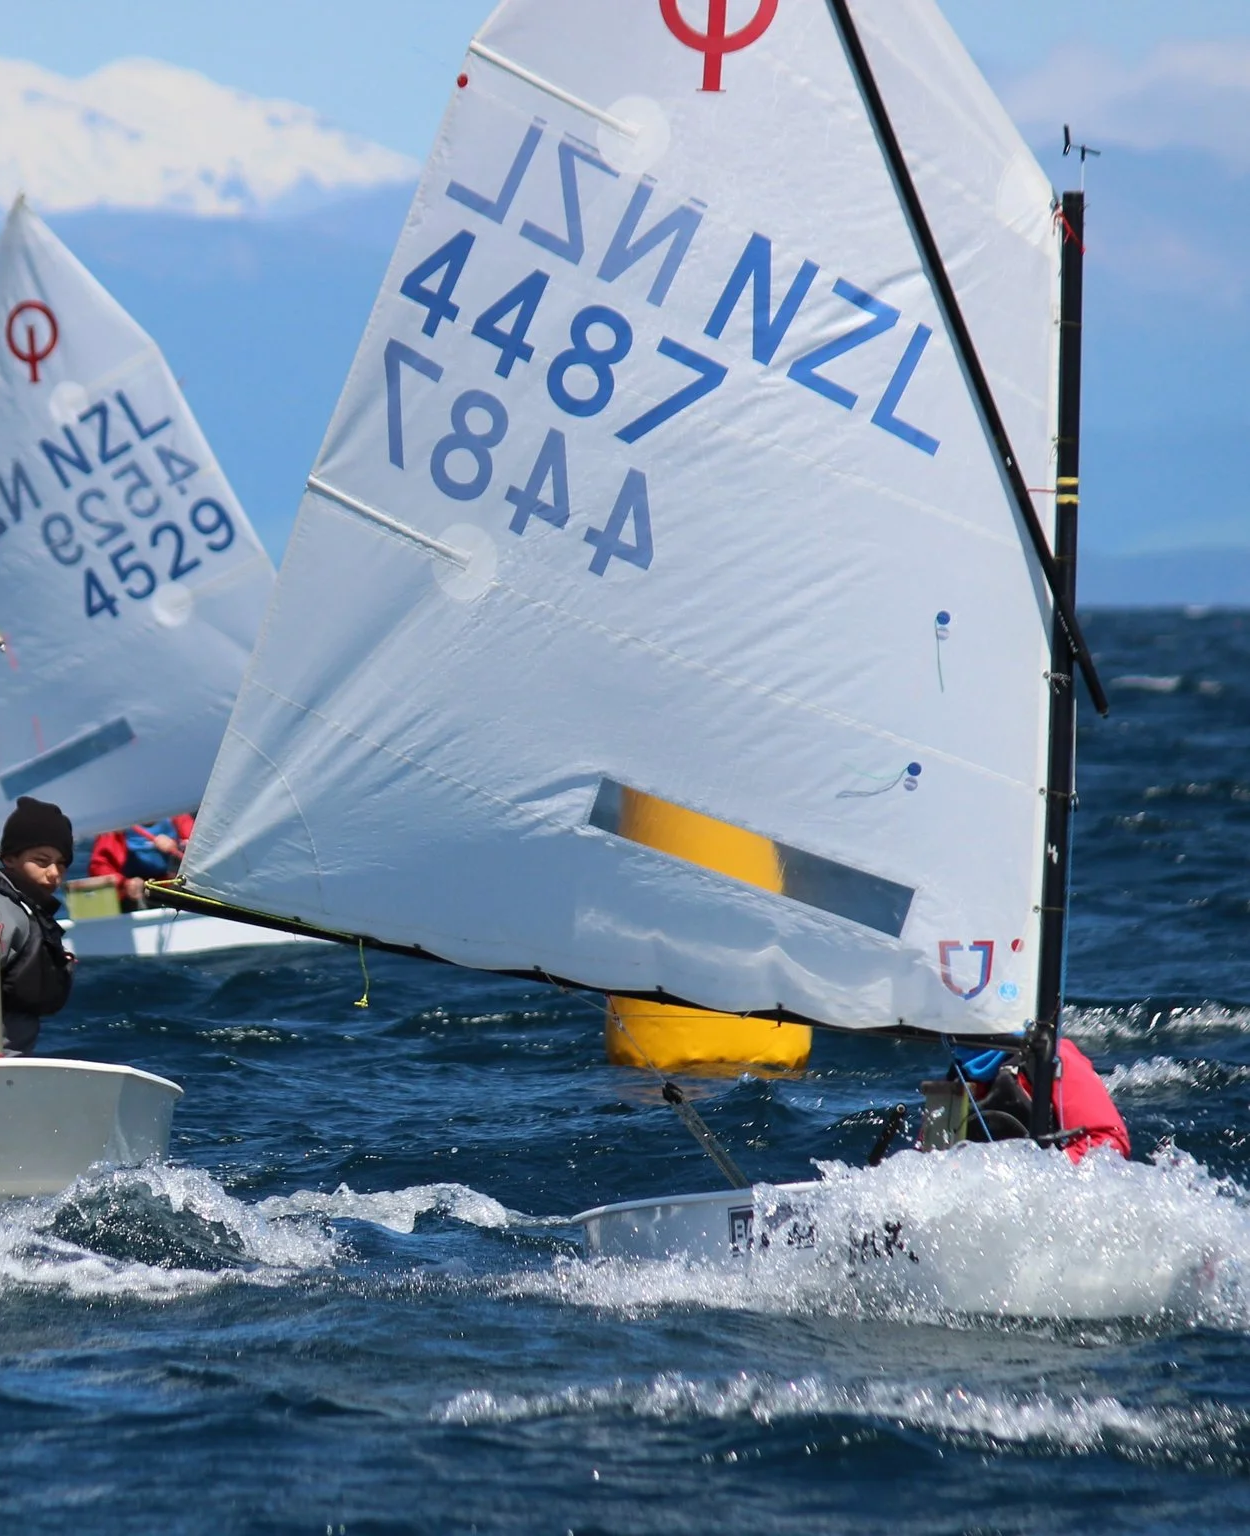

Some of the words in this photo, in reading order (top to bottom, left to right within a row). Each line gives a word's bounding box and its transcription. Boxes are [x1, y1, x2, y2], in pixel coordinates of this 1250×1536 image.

[399, 229, 729, 444] 4487
[703, 232, 940, 457] NZL
[39, 389, 172, 489] NZL
[84, 497, 236, 620] 4529
